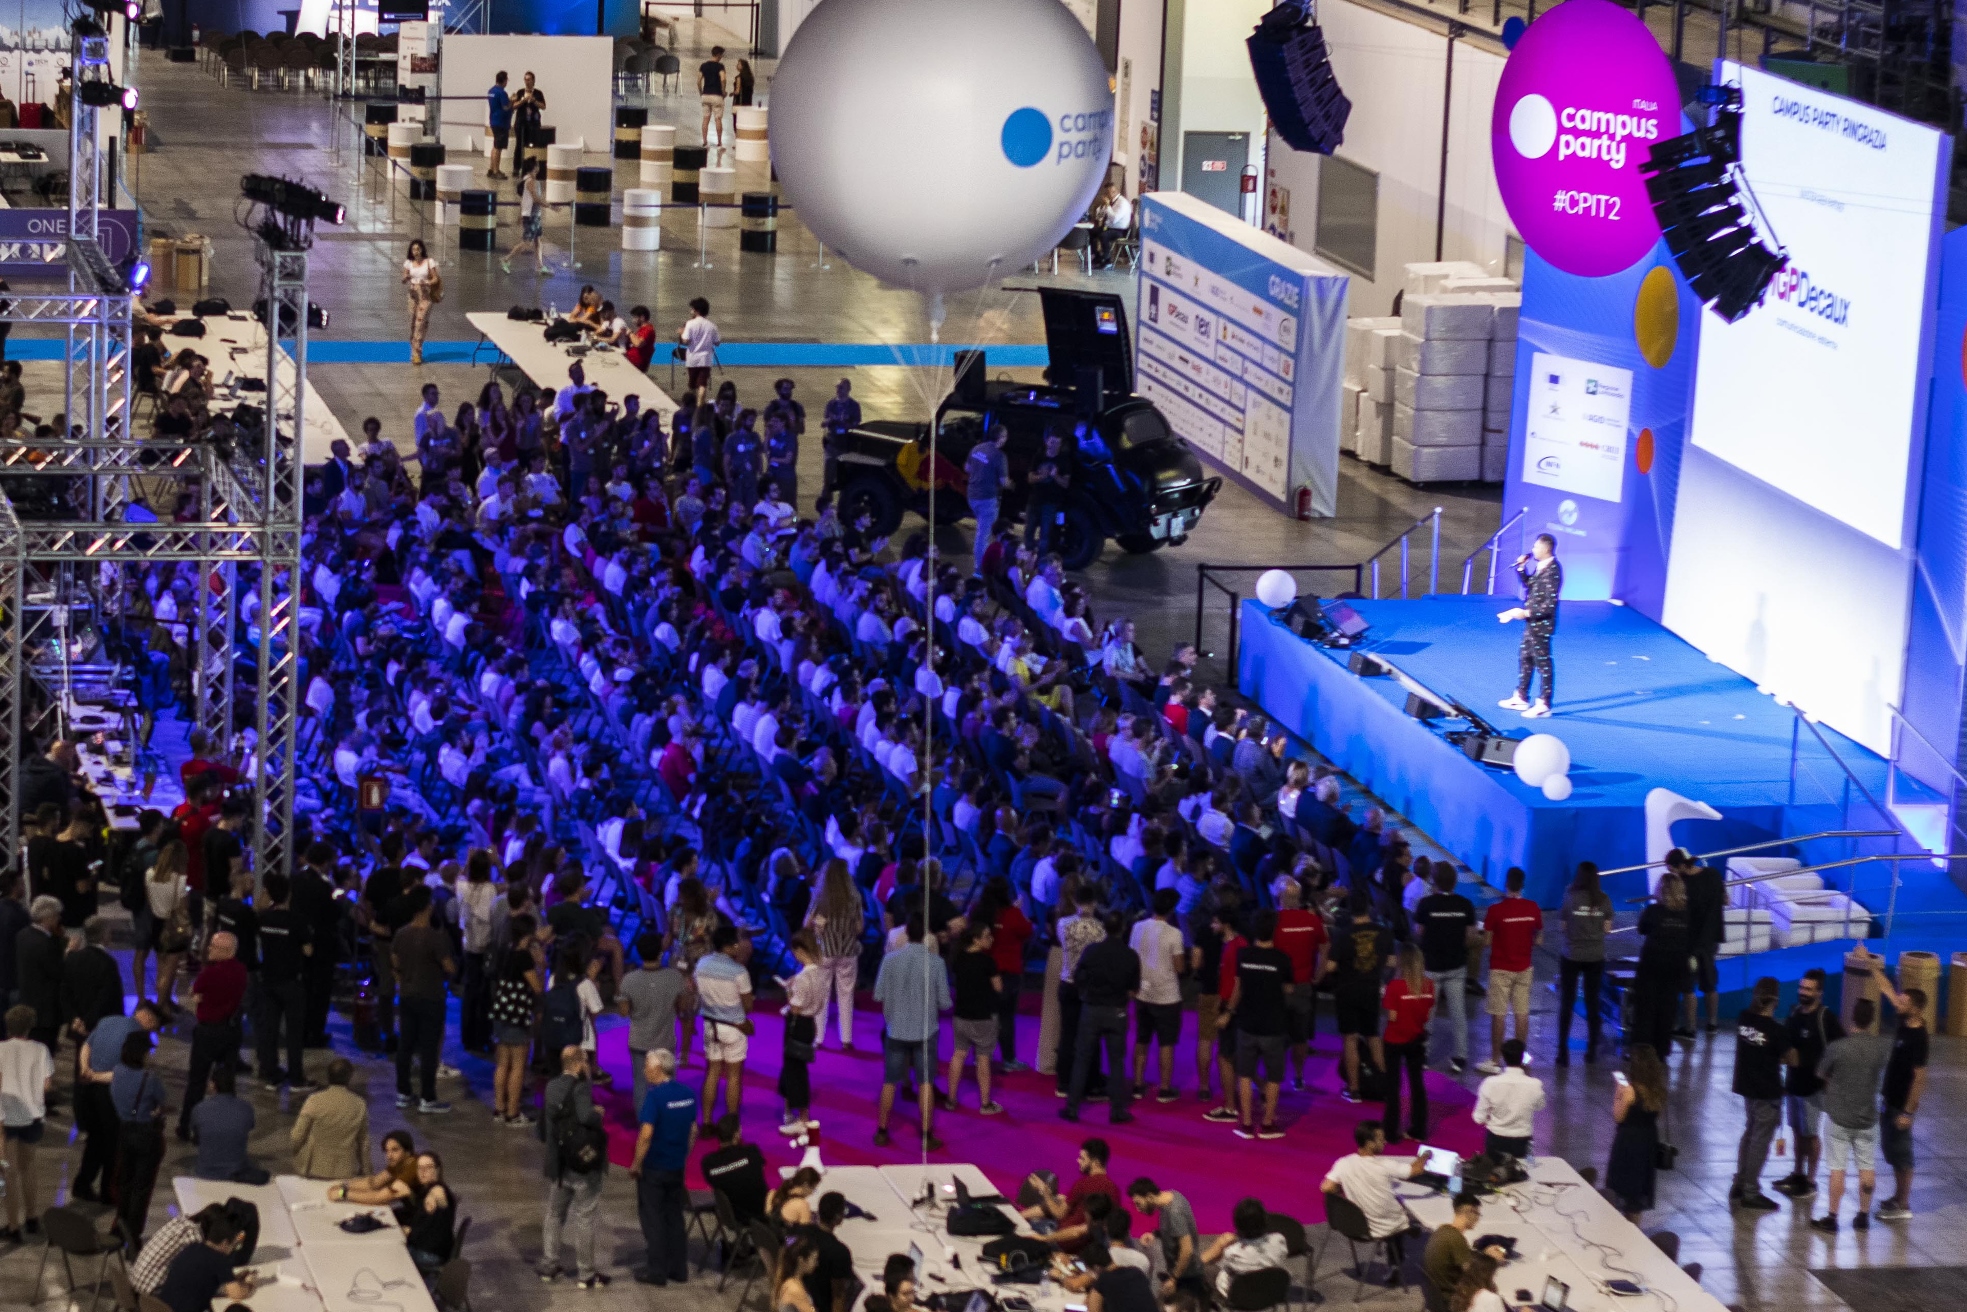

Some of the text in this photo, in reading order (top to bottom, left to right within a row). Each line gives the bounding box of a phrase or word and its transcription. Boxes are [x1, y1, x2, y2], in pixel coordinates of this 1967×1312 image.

[1631, 98, 1658, 111] ITALIA
[1560, 106, 1658, 141] campus
[1773, 96, 1887, 152] CAMPUS PARTY RINGRAZIA
[1558, 133, 1626, 169] party
[1552, 189, 1621, 220] #CPIT2
[27, 219, 67, 234] ONE
